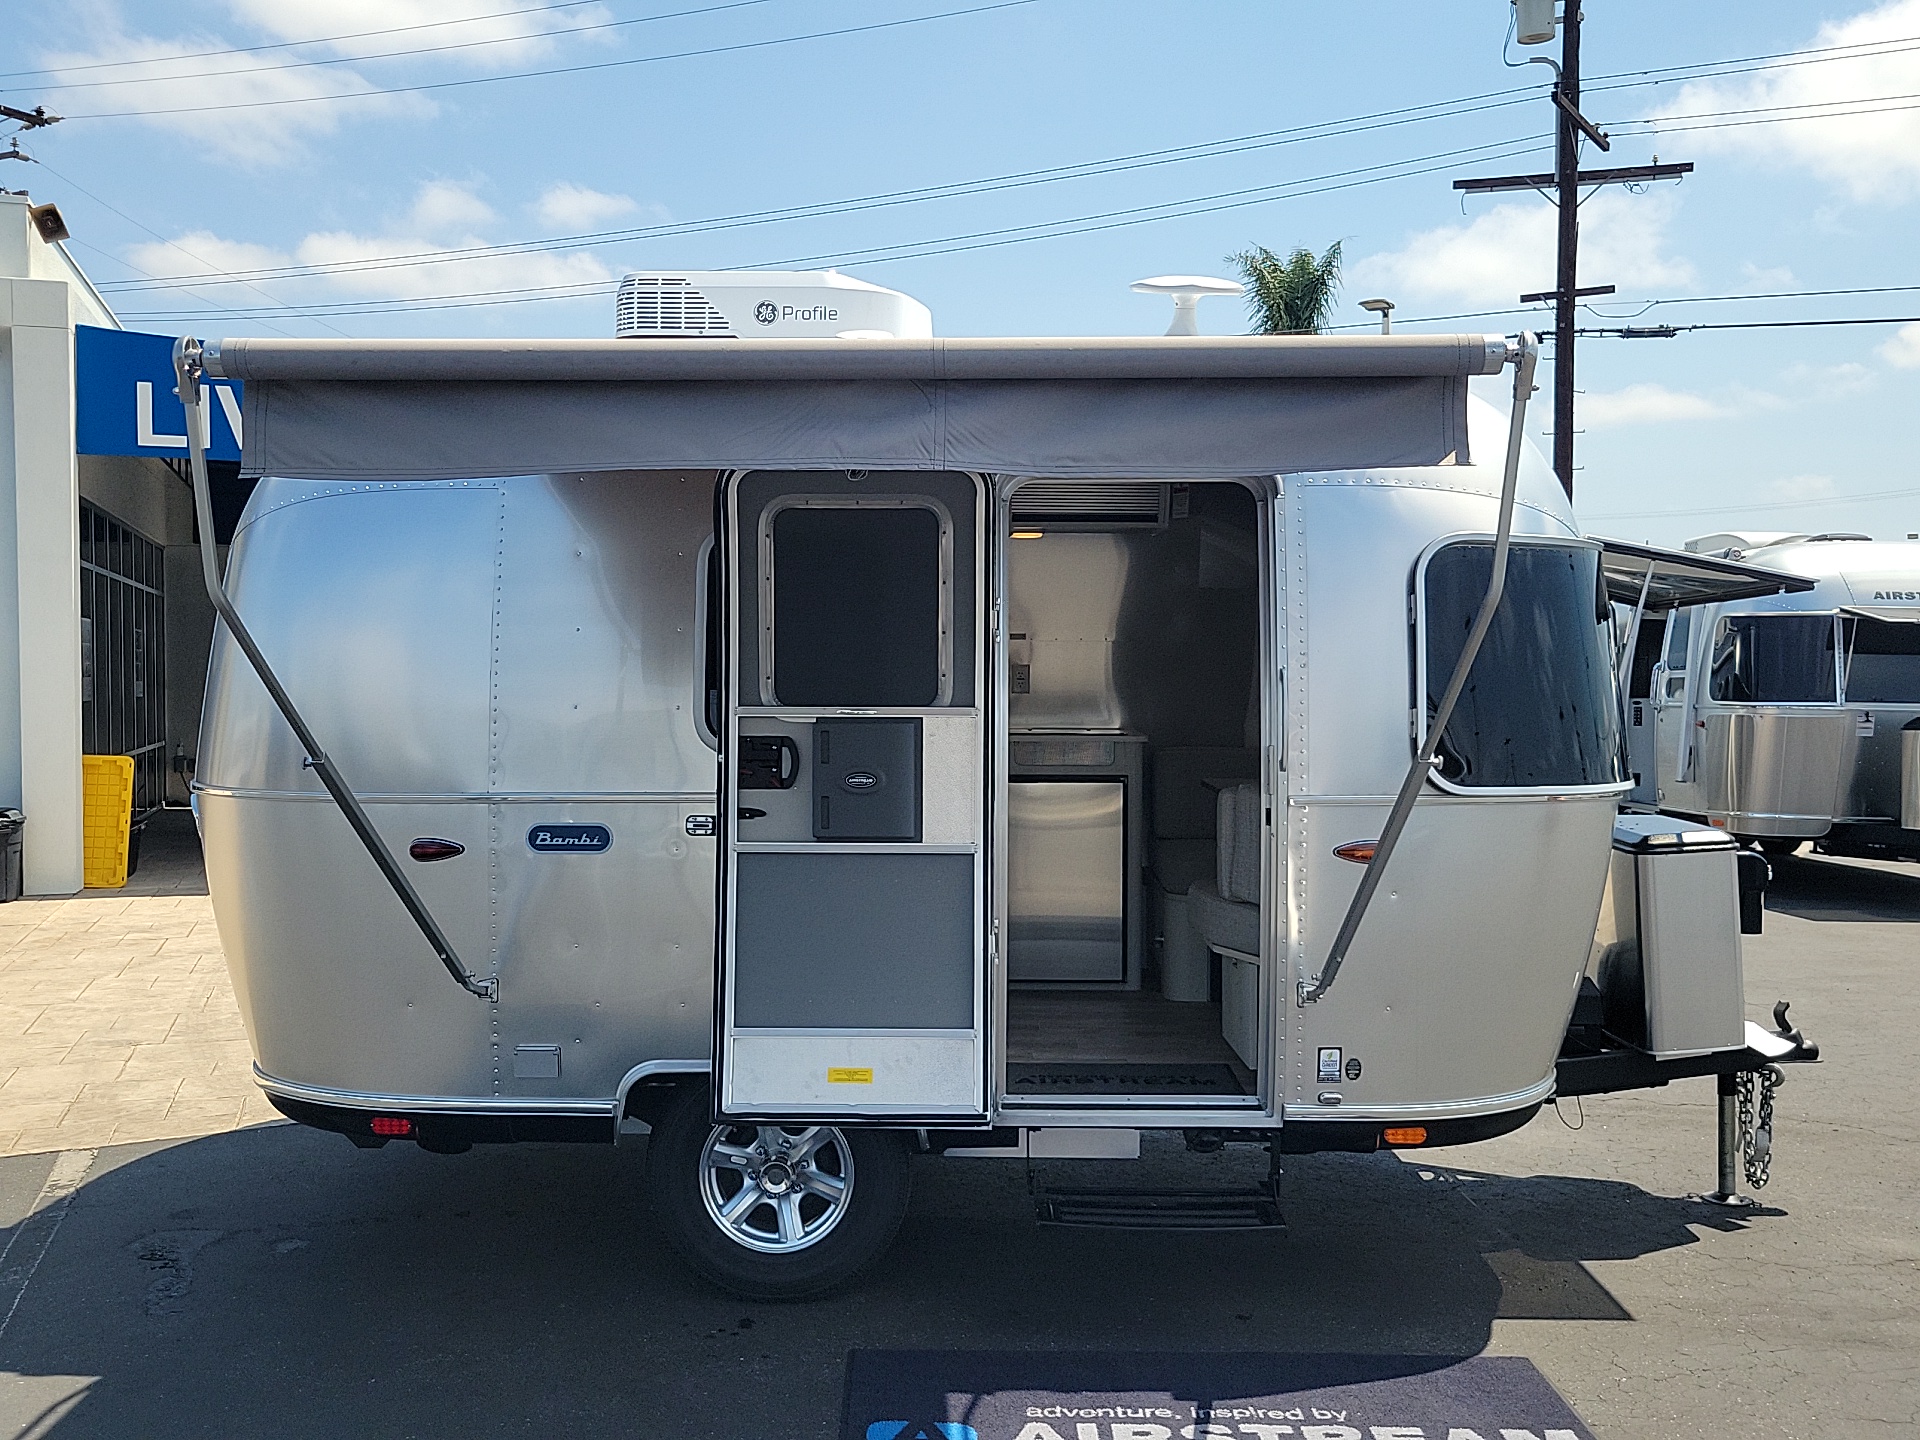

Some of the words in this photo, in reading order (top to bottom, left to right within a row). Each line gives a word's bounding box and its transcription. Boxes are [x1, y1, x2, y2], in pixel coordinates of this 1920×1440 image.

[782, 305, 838, 321] Profile
[535, 832, 602, 845] Bambi
[1026, 1405, 1182, 1420] adventure,
[1190, 1405, 1304, 1420] inspired
[1311, 1407, 1347, 1422] by
